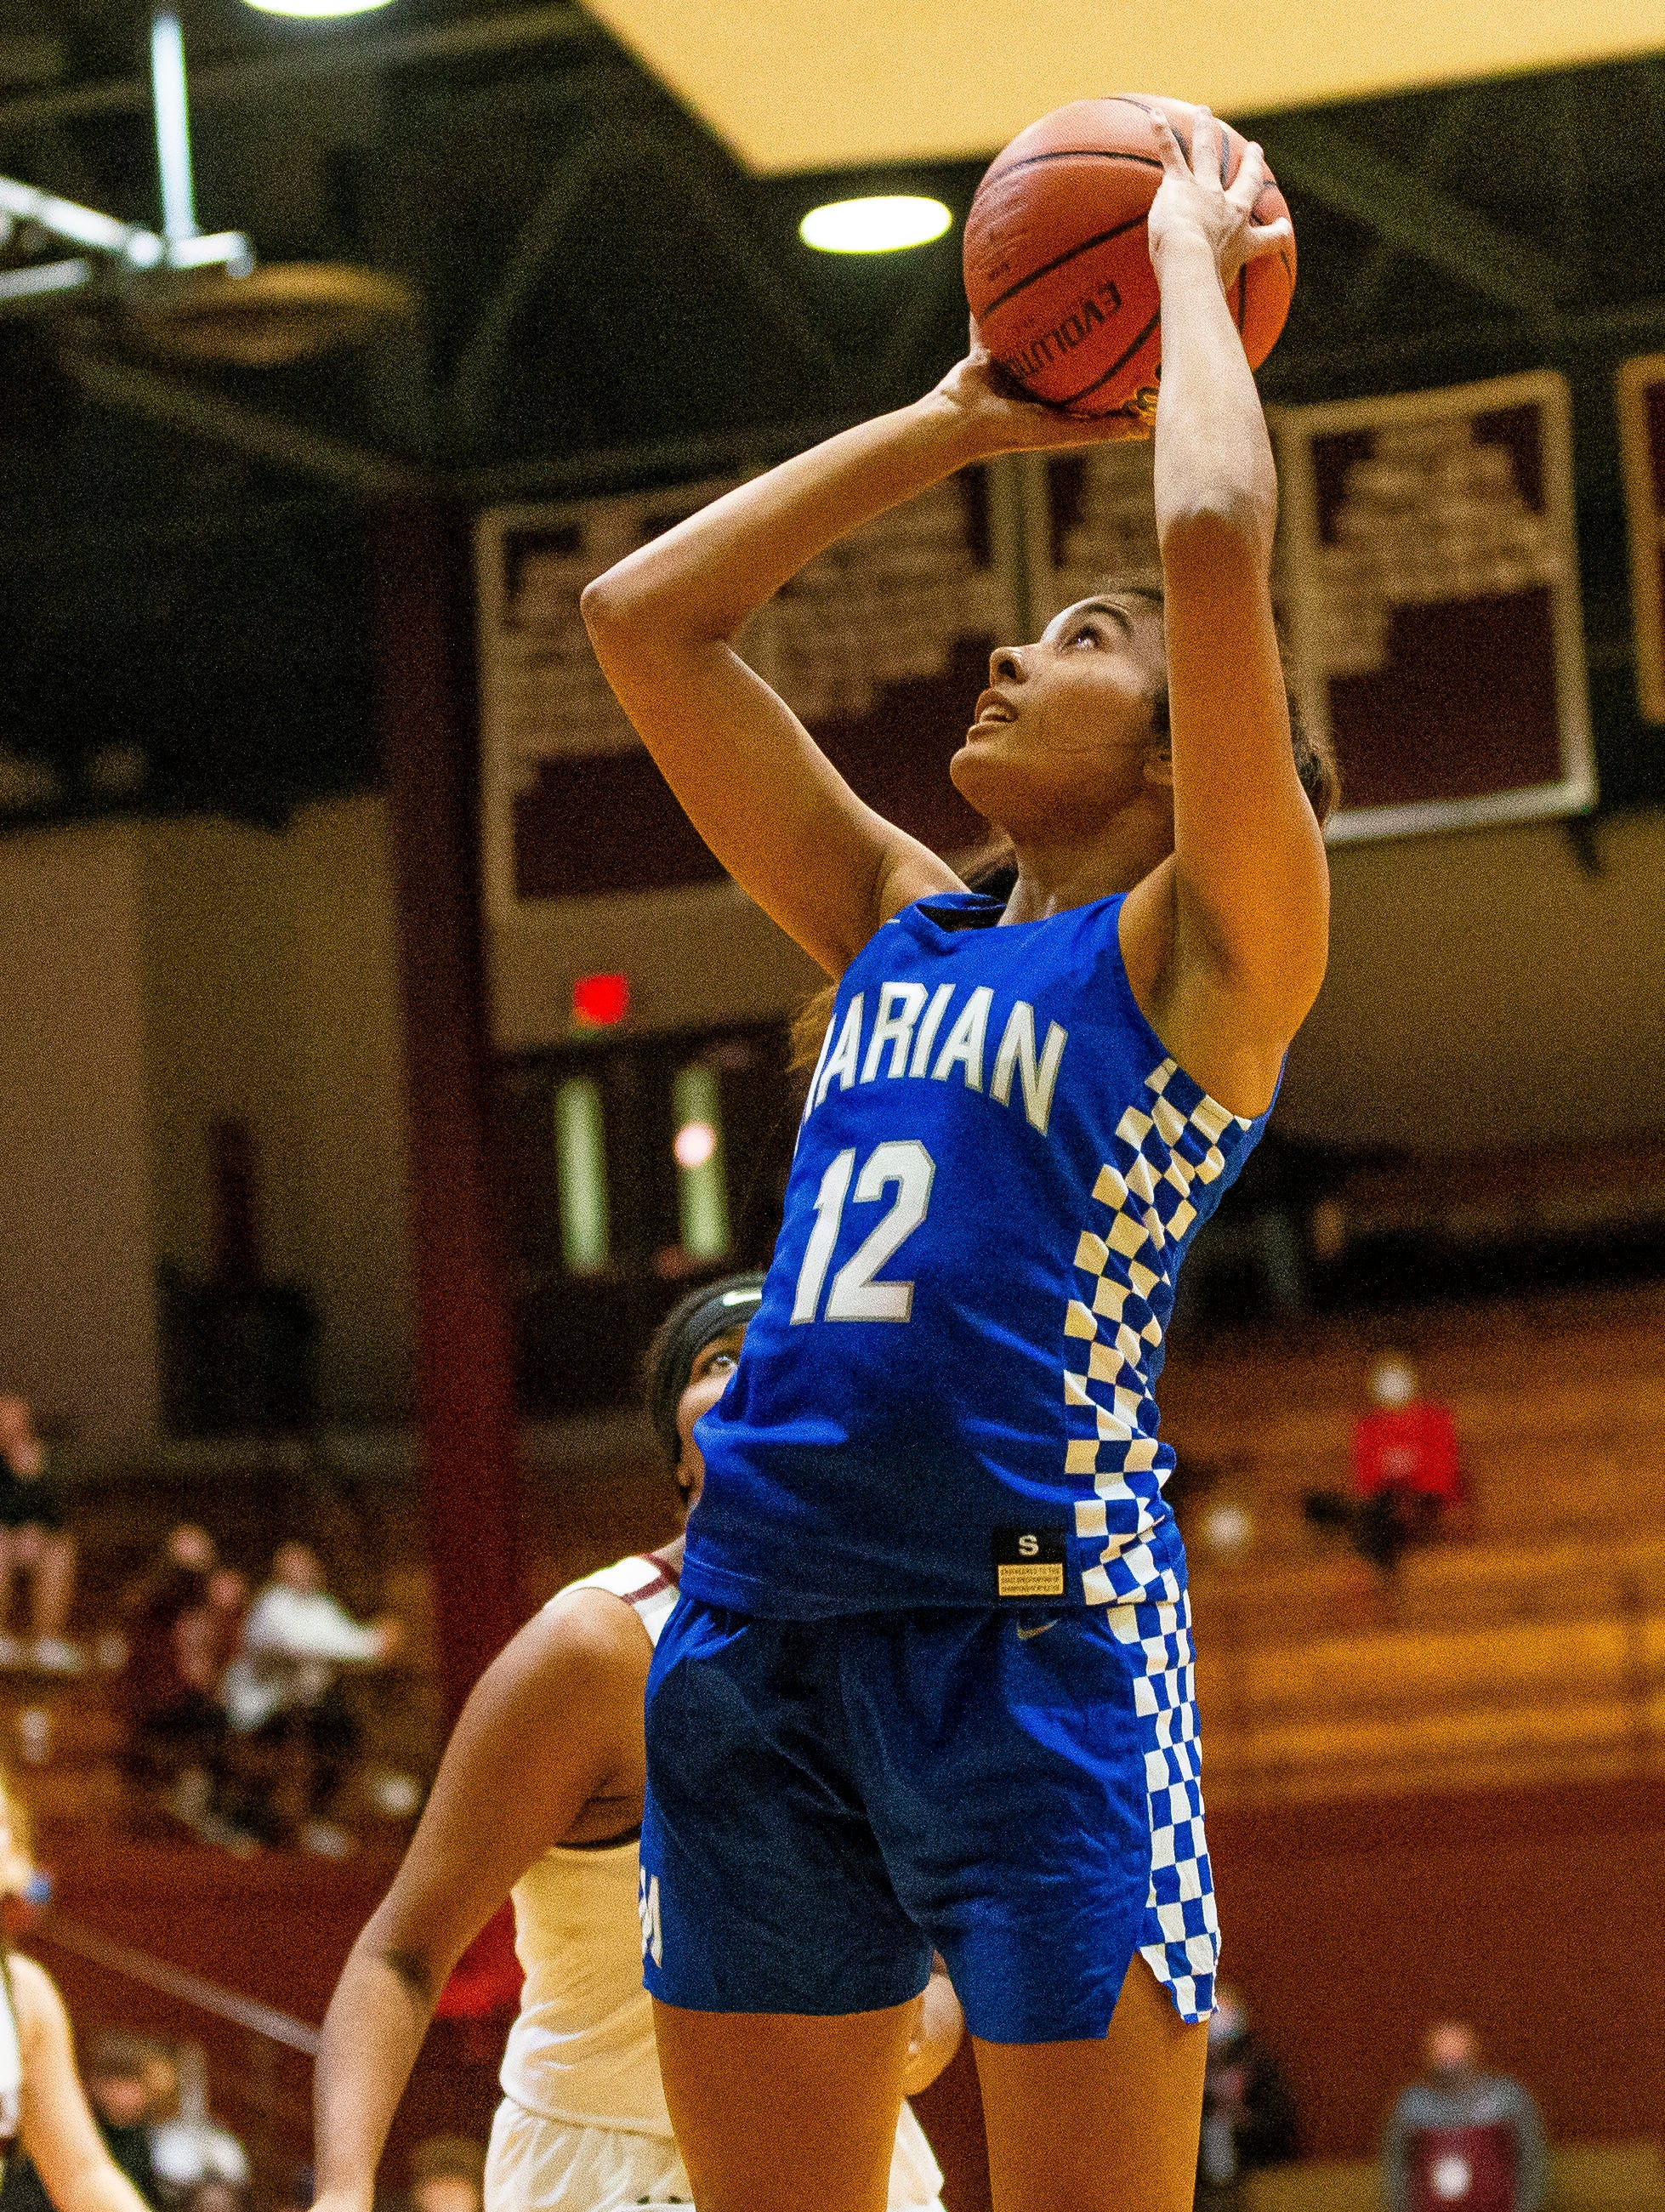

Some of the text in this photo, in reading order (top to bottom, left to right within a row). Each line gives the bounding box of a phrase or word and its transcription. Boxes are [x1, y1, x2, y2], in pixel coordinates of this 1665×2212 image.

[1005, 280, 1122, 378] EVOLUTI
[798, 981, 1069, 1141] ARIAN
[790, 1140, 935, 1325] 12
[1019, 1534, 1038, 1556] S
